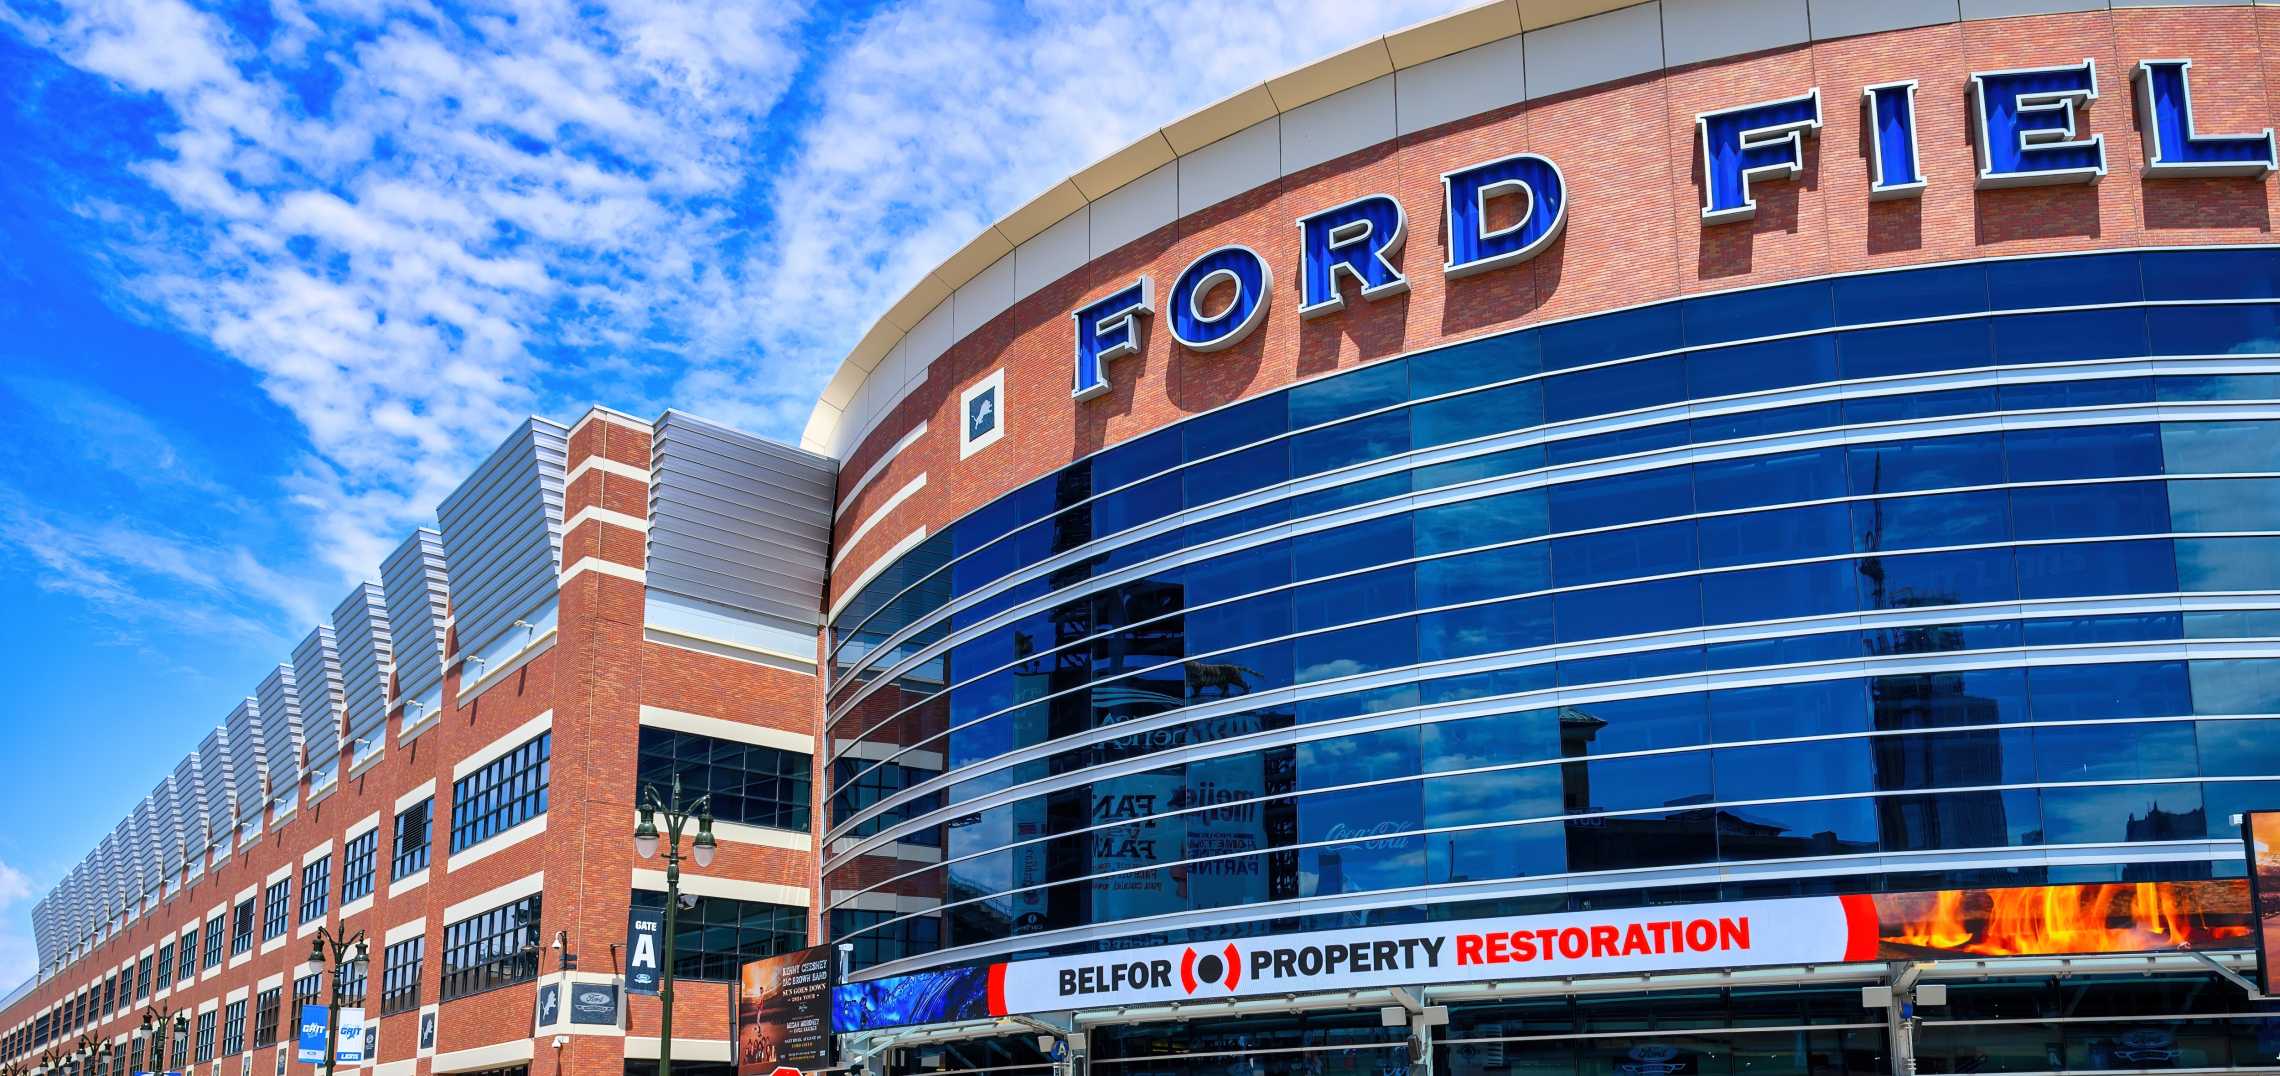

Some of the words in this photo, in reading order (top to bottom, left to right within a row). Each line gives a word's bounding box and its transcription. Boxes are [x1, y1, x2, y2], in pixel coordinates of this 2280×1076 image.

[1072, 152, 1571, 400] FORD
[635, 920, 657, 932] GATE
[632, 934, 656, 968] A
[1059, 959, 1172, 996] BELFOR
[1250, 936, 1446, 980] PROPERTY
[1456, 917, 1750, 966] RESTORATION
[303, 1023, 326, 1034] GRIT
[340, 1027, 362, 1037] GRIT
[1057, 1042, 1068, 1056] A
